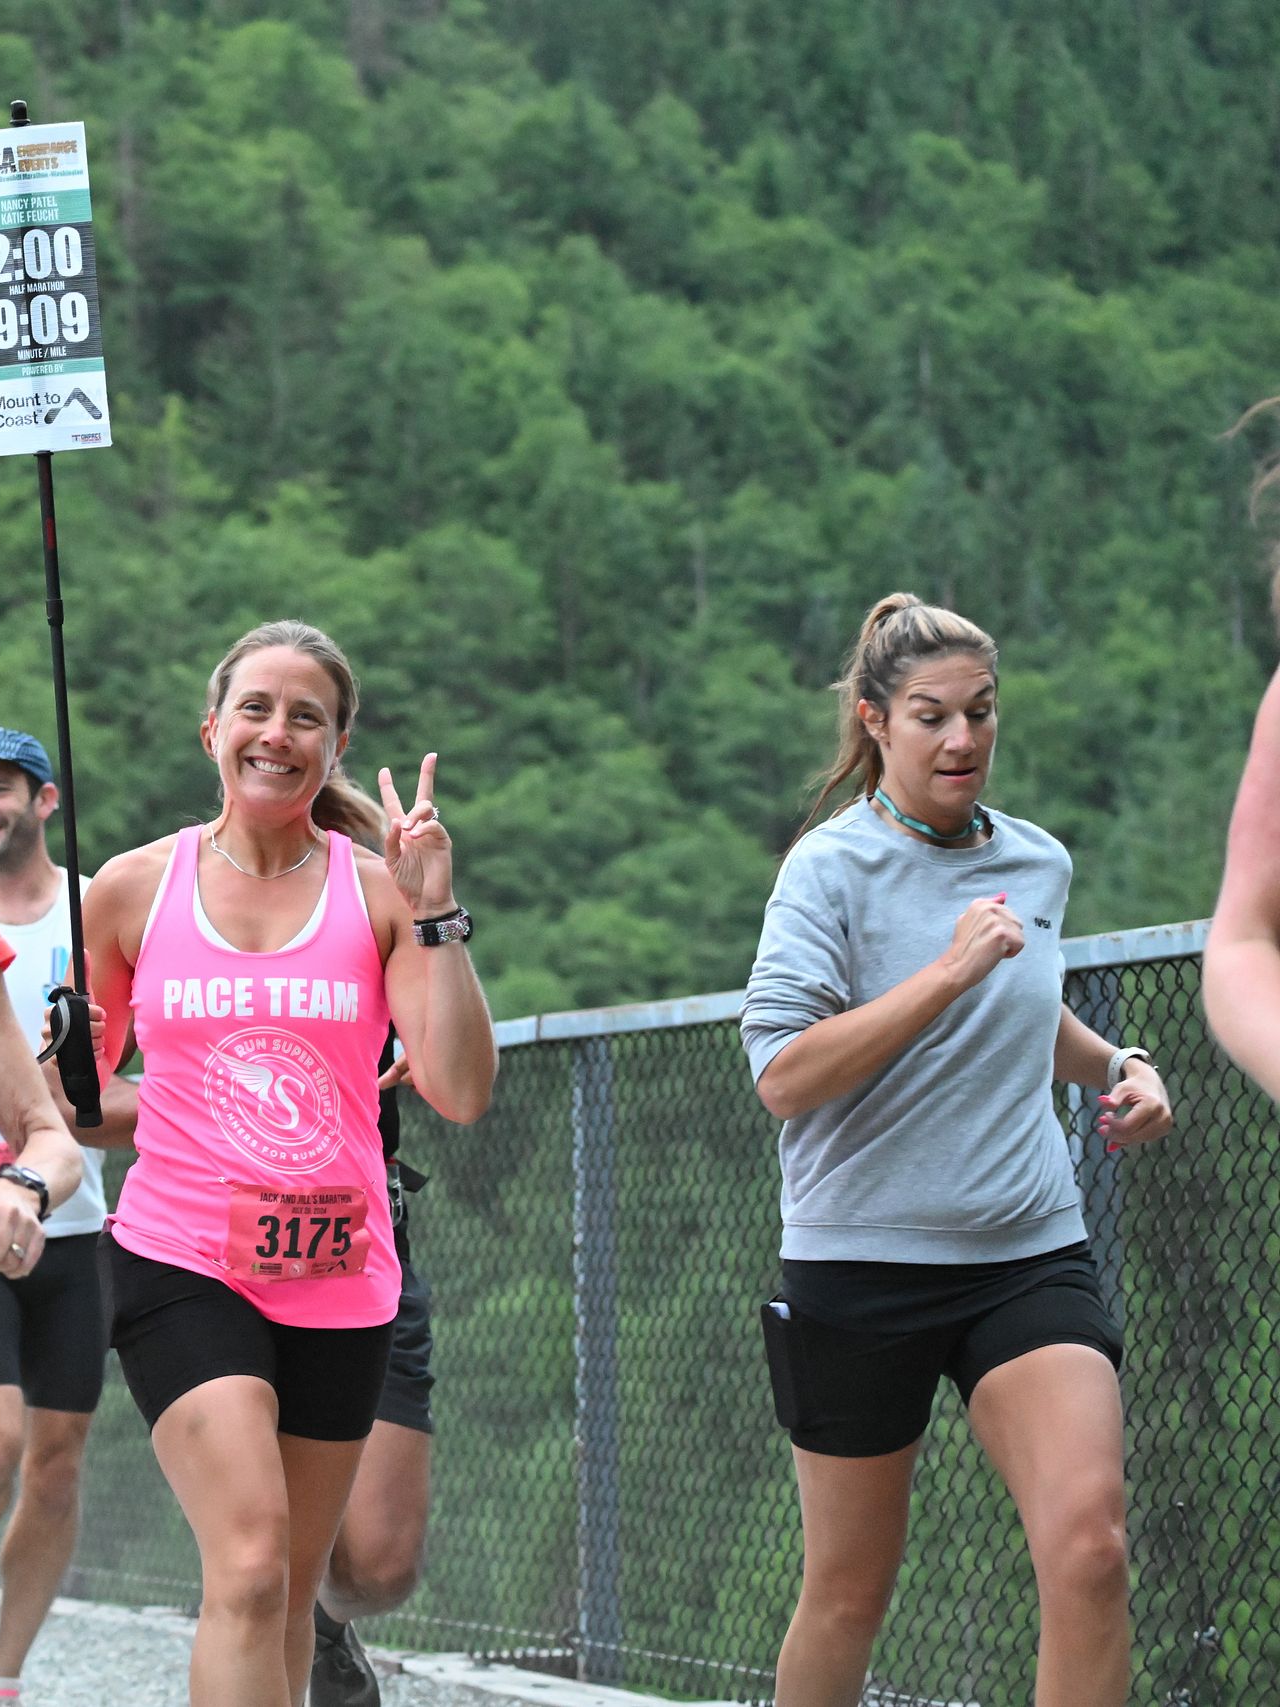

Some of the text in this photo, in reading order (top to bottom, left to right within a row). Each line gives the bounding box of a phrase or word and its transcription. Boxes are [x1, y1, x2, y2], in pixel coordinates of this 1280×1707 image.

[18, 157, 59, 173] EVENTS
[0, 196, 58, 212] NANCY PATEL
[1, 211, 25, 225] KATIE
[9, 281, 65, 296] HALF MARATHON
[17, 348, 43, 360] MINUTE
[50, 346, 67, 357] MILE
[22, 364, 64, 376] POWERED BY
[43, 392, 61, 405] to
[163, 977, 359, 1023] PACE TEAM
[233, 1038, 334, 1117] RUN SUPER SERIES
[218, 1097, 259, 1148] RUNNERS
[261, 1148, 287, 1160] FOR
[292, 1129, 337, 1161] RUNNERS
[260, 1192, 279, 1203] JACK
[280, 1194, 296, 1204] AND
[319, 1194, 352, 1204] MARATHON
[255, 1215, 352, 1259] 3175
